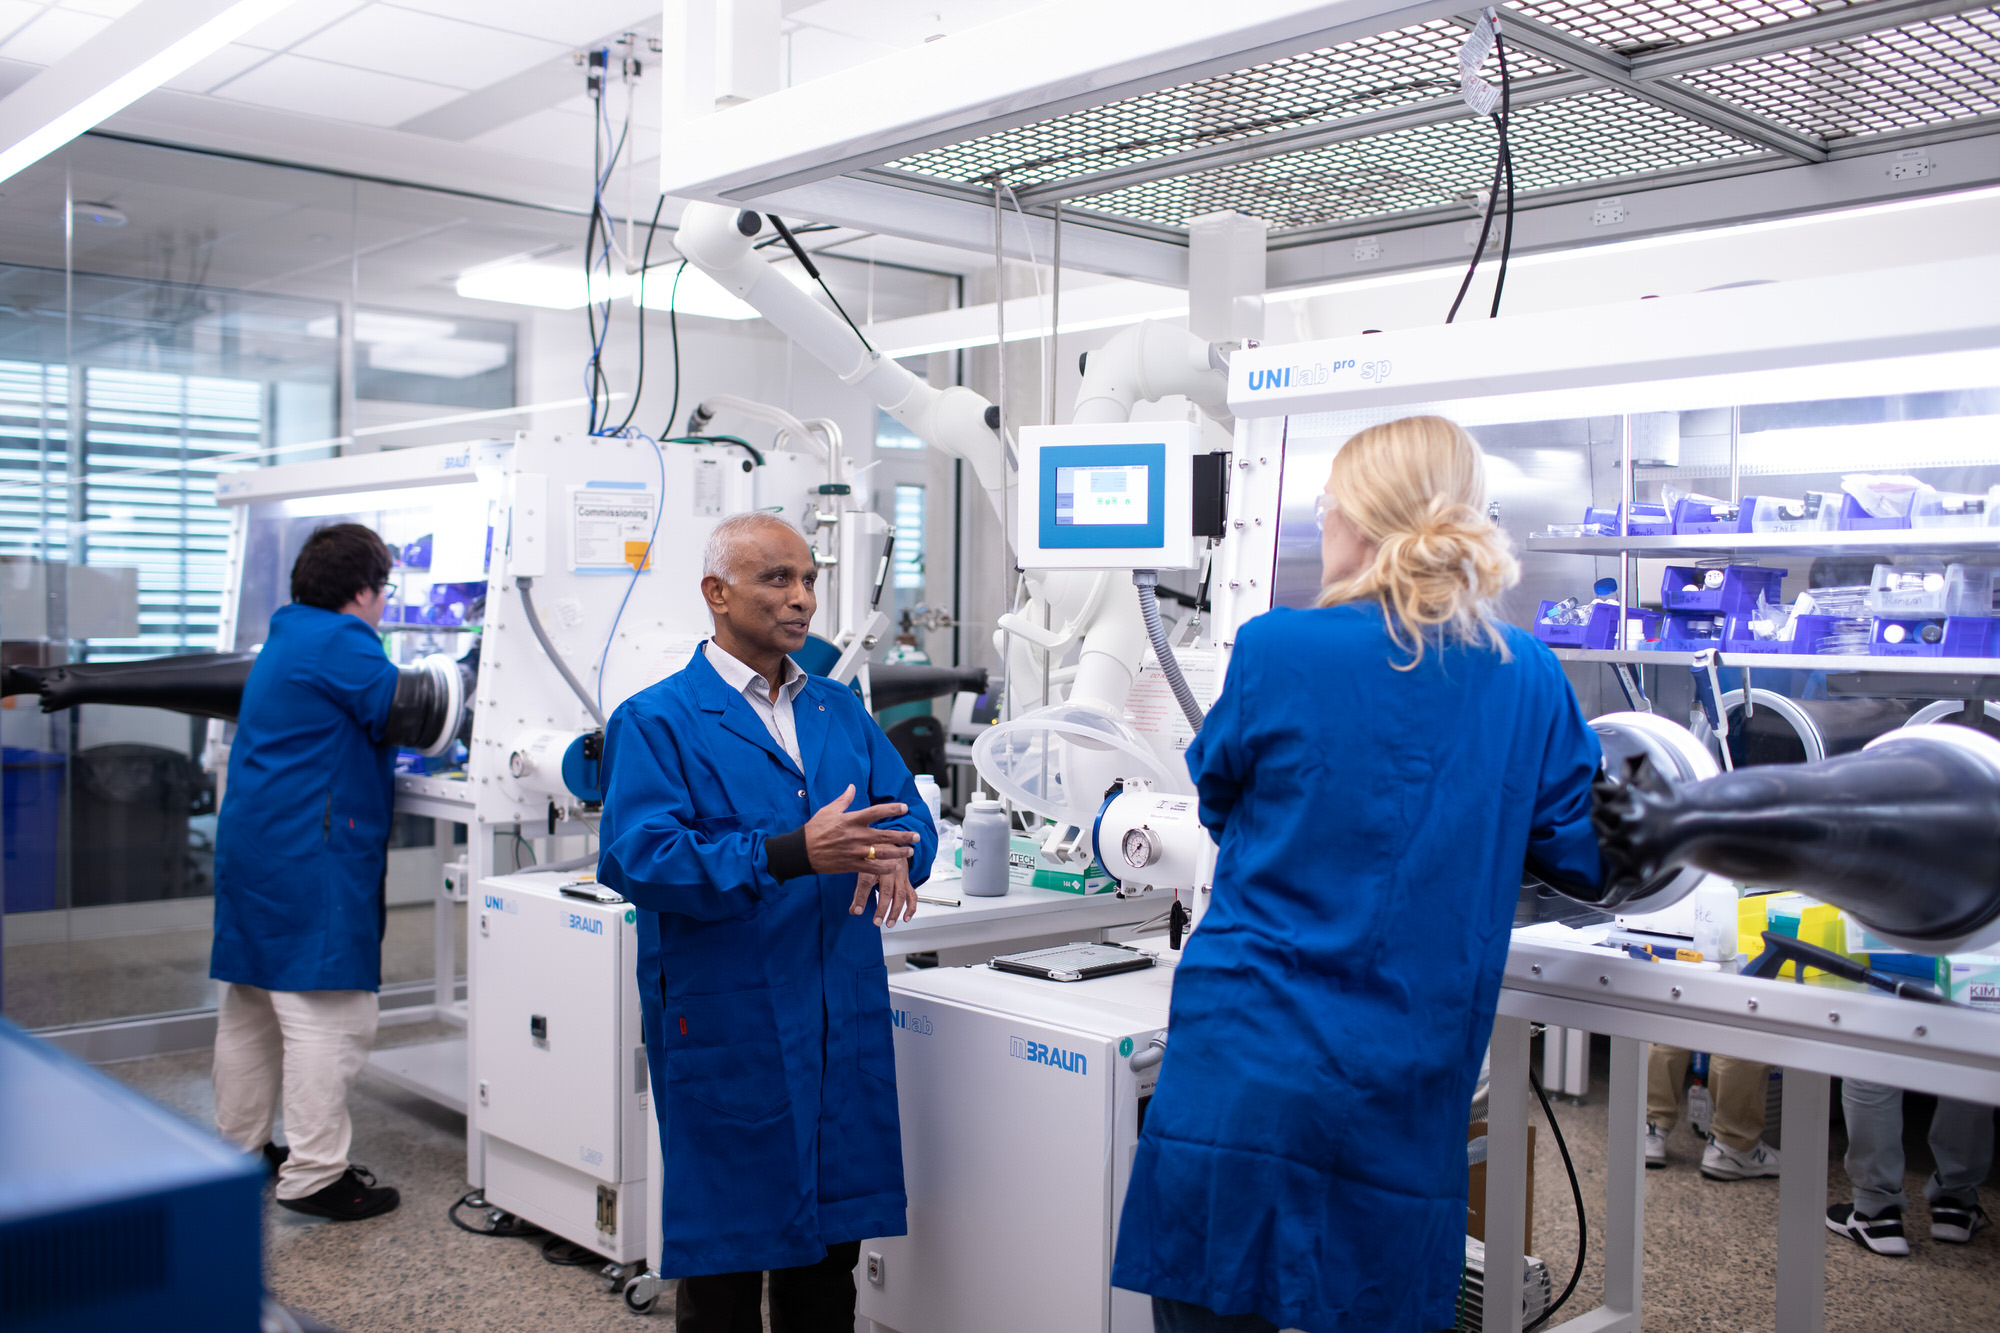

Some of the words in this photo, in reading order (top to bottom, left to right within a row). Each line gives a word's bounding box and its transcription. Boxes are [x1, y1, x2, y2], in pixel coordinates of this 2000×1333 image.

[1248, 363, 1329, 391] UNIlab
[1333, 359, 1355, 373] pro
[1360, 359, 1392, 383] sp
[578, 506, 648, 520] Commissioning
[1009, 853, 1035, 864] TECH
[559, 910, 603, 935] BRAUN
[890, 1008, 933, 1036] NIlab
[1009, 1035, 1087, 1075] mBRAUN
